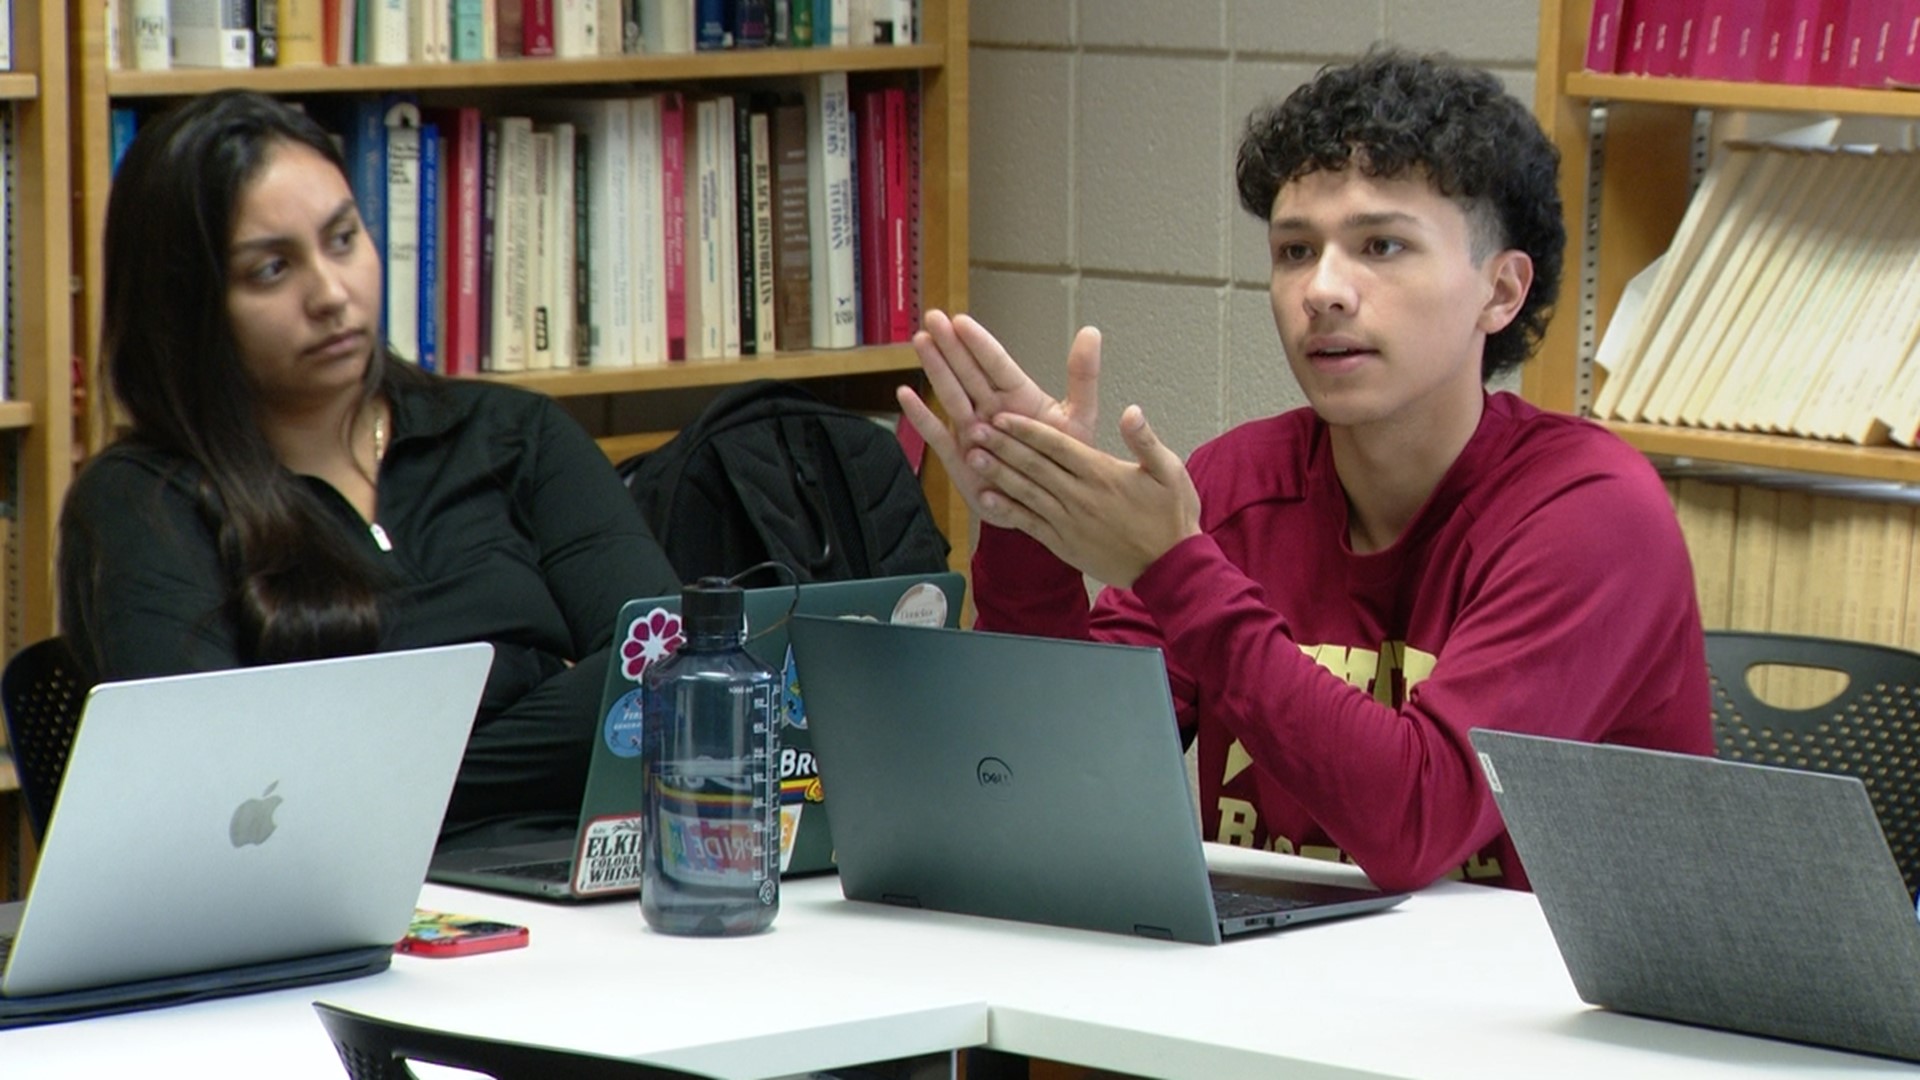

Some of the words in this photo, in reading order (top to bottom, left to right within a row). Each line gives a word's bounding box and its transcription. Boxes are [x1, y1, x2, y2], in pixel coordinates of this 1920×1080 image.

[756, 164, 769, 213] BLACK
[896, 218, 905, 264] Community
[758, 216, 772, 305] HISTORIANS
[897, 276, 906, 311] America
[781, 748, 818, 777] BR
[586, 833, 641, 859] ELKI
[591, 855, 641, 868] COLORA
